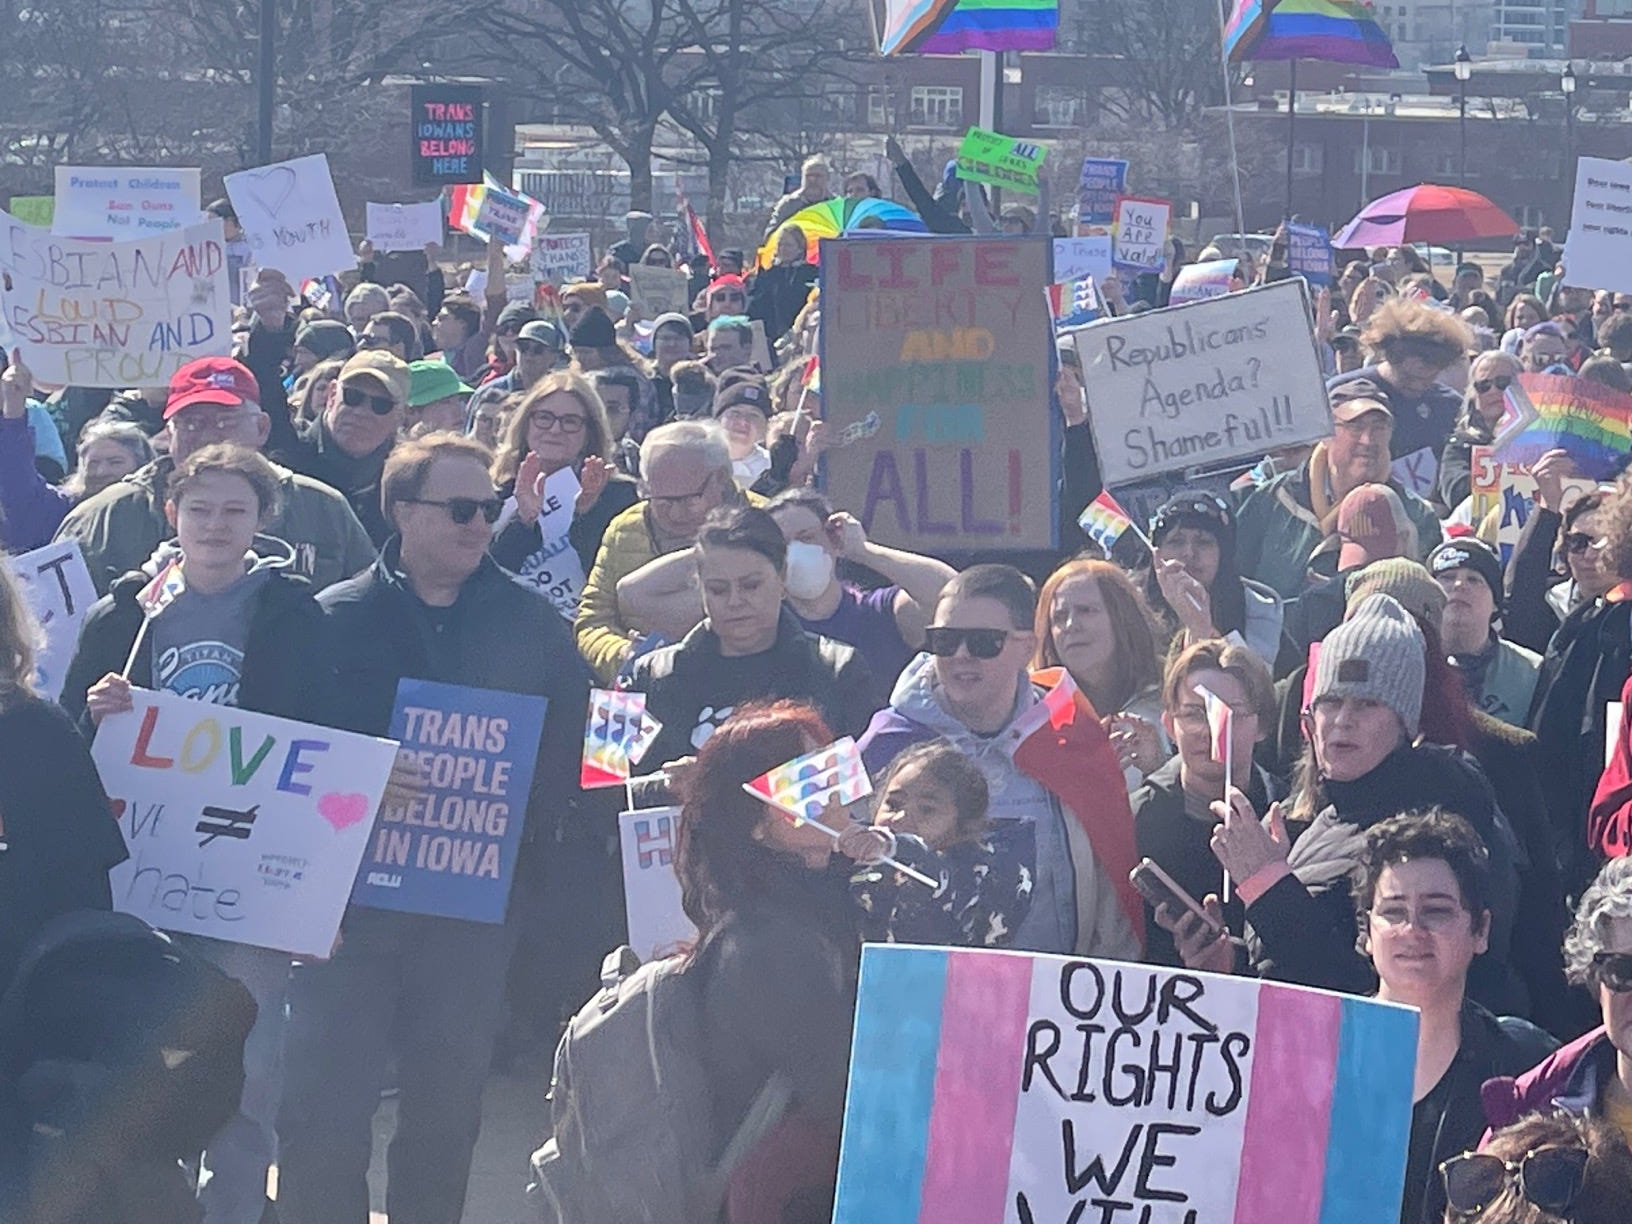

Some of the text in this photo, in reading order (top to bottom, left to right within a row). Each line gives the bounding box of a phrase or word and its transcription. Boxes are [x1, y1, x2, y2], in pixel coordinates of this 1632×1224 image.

[418, 123, 474, 139] IOWANS
[424, 103, 474, 121] TRANS
[420, 140, 475, 157] BELONG
[432, 158, 468, 175] HERE
[1010, 142, 1039, 162] ALL
[70, 175, 181, 190] Protect Children
[107, 214, 181, 229] Not People
[1126, 208, 1153, 227] You
[167, 240, 223, 281] AND
[837, 243, 1020, 290] LIFE
[36, 287, 144, 324] LOUD
[837, 287, 1024, 331] LIBERTY
[149, 312, 215, 352] AND
[901, 327, 995, 361] AND
[1139, 356, 1262, 421] Agenda?
[895, 402, 986, 443] FOR
[1124, 394, 1295, 470] Shameful!!
[861, 448, 1024, 535] ALL!
[130, 705, 331, 796] LOVE
[403, 705, 510, 754] TRANS
[400, 748, 513, 796] PEOPLE
[385, 791, 509, 837] BELONG
[373, 828, 501, 880] IN IOWA
[126, 844, 247, 922] hate
[366, 871, 404, 891] ACLU
[1060, 960, 1219, 1034] OUR
[1021, 1018, 1251, 1117] RIGHTS
[1061, 1118, 1202, 1203] WE
